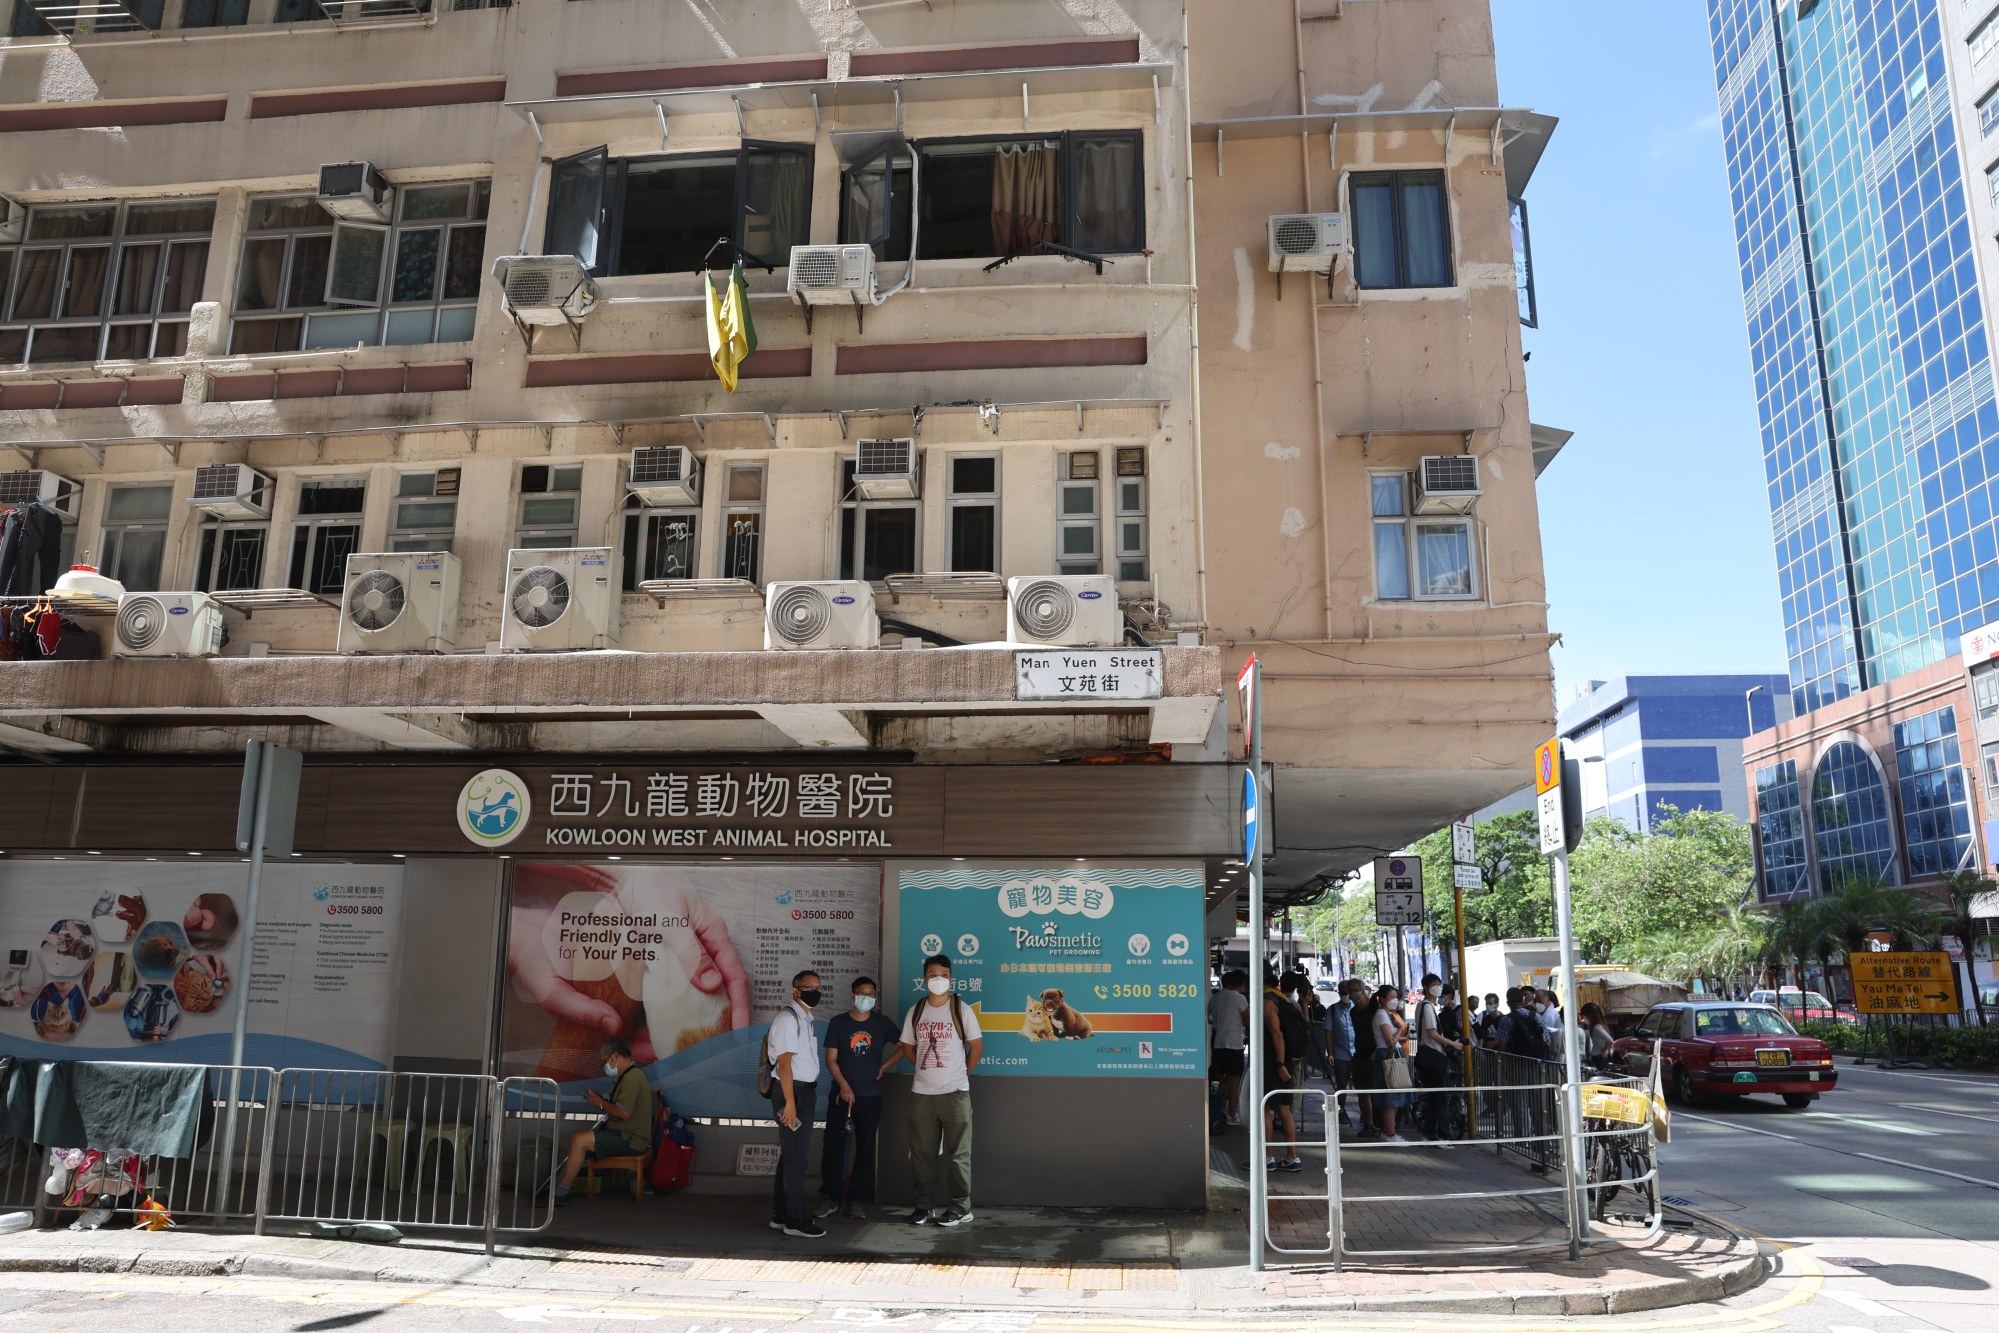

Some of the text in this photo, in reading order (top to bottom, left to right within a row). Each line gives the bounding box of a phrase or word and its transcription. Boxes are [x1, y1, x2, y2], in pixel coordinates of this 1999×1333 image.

[1021, 656, 1155, 669] Man Yuen Street
[1058, 674, 1120, 692] 文苑街
[549, 772, 893, 819] 西九龍動物醫院
[1543, 795, 1555, 814] End
[546, 827, 892, 847] KOWLOON WEST ANIMAL HOSPITAL
[1006, 884, 1104, 910] 寵物美容
[1404, 895, 1413, 906] 7
[337, 905, 383, 915] 3500 5800
[802, 910, 854, 920] 3500 5800
[1406, 912, 1420, 923] 12
[560, 912, 690, 928] Professional and
[559, 929, 663, 947] Friendly Care
[1008, 925, 1101, 950] Pawsmetic
[559, 946, 660, 962] for Your Pets.
[1860, 956, 1941, 965] Alternative Route
[1872, 966, 1933, 978] 替代路線
[1112, 984, 1198, 998] 3500 5820
[1861, 984, 1923, 994] Yau Ma Tei
